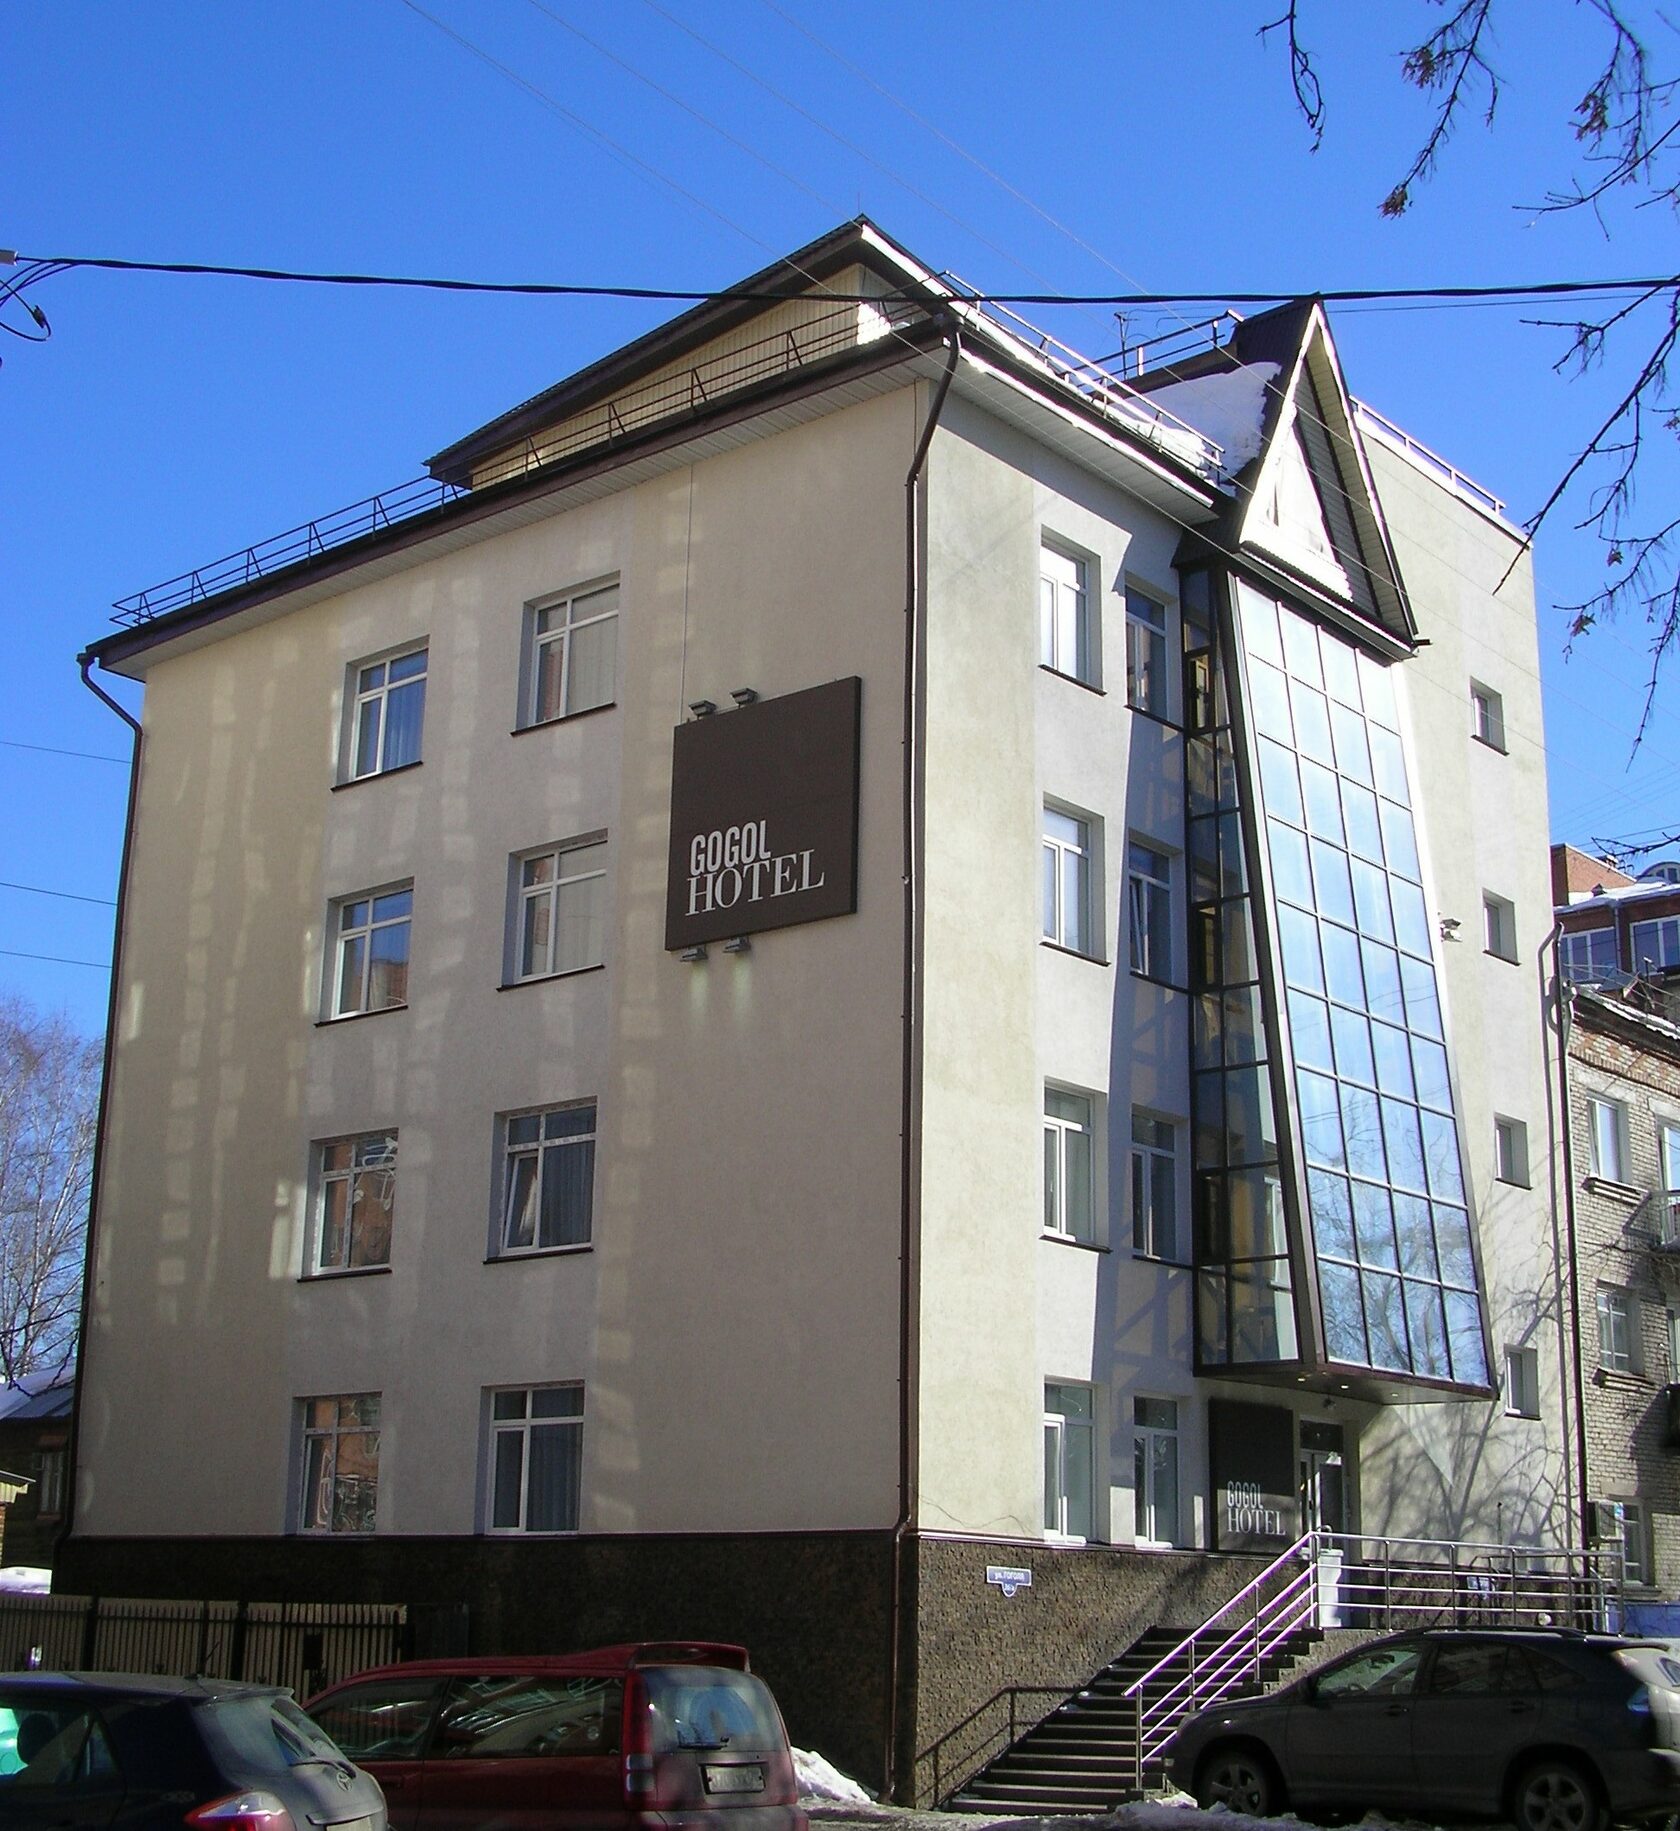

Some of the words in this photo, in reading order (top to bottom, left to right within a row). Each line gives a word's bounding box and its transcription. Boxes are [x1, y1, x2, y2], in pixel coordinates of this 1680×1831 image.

[690, 819, 771, 876] GOGOL
[685, 848, 825, 916] HOTEL
[1227, 1480, 1263, 1509] GOGOL
[1227, 1508, 1286, 1536] HOTEL
